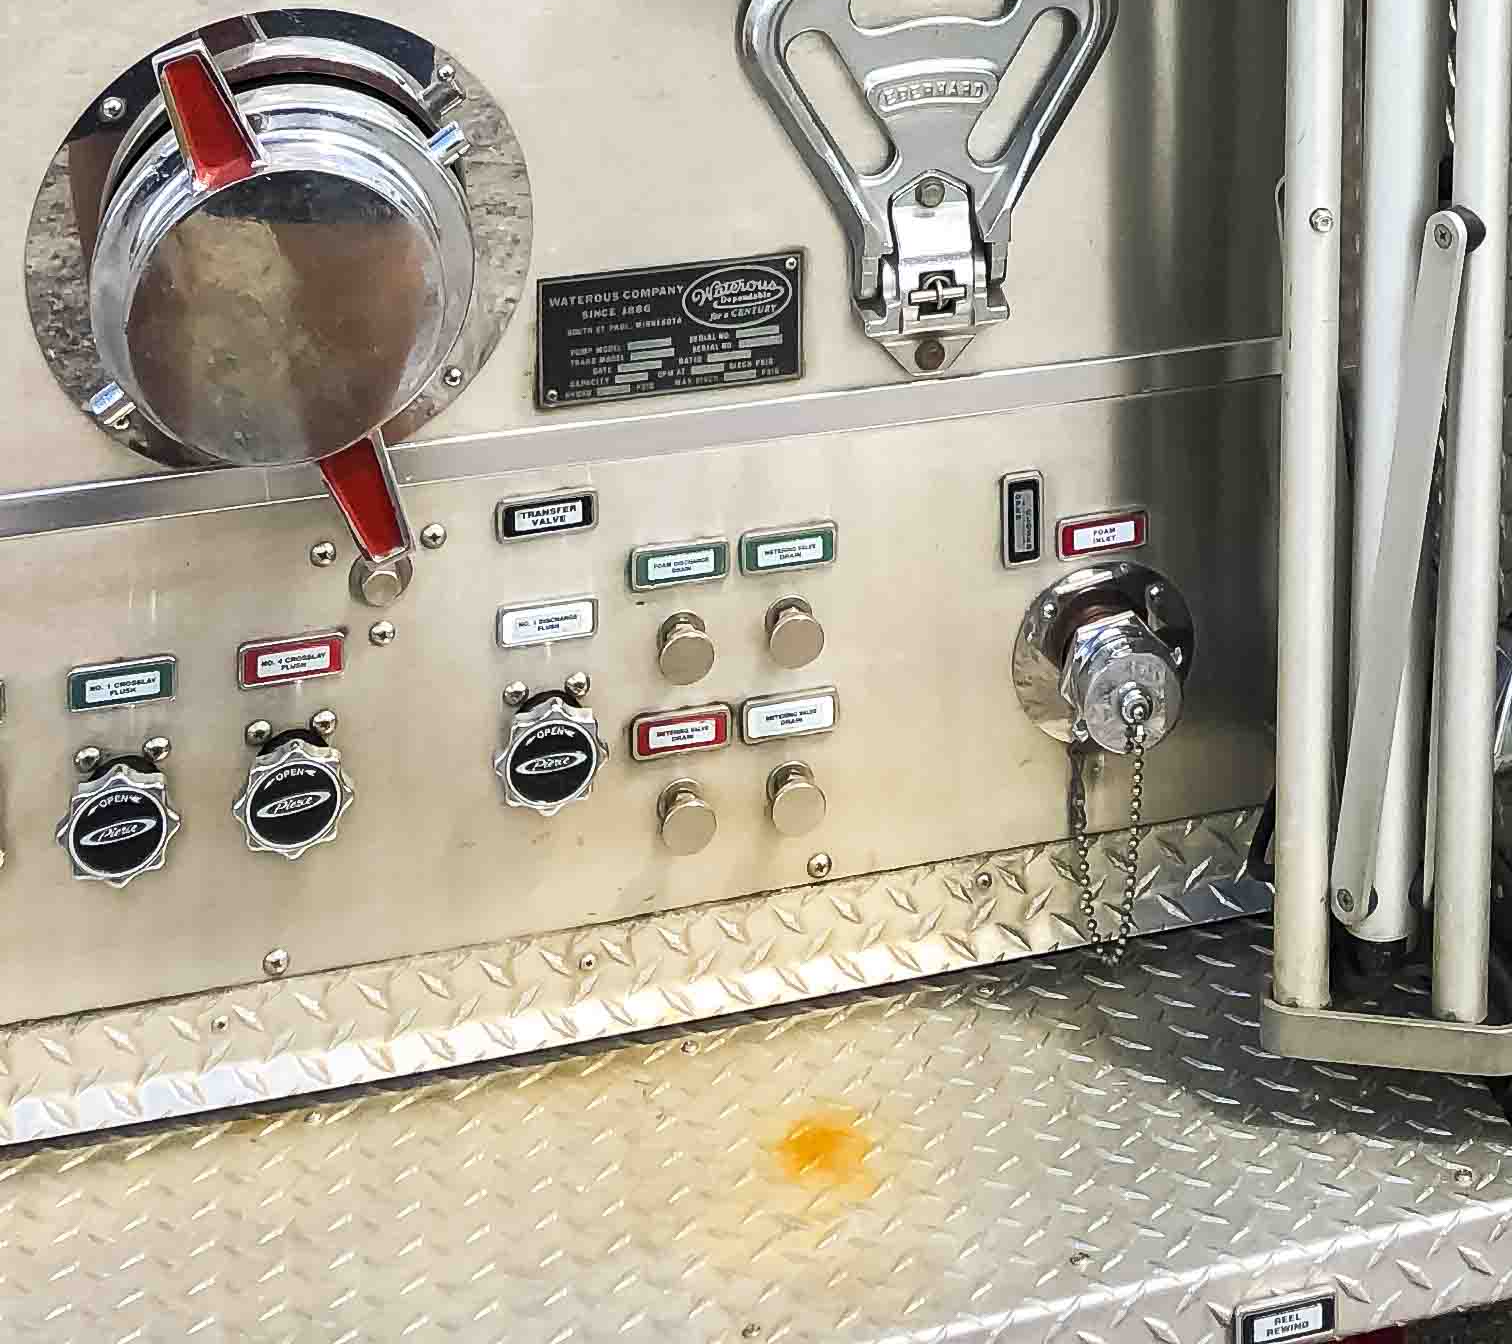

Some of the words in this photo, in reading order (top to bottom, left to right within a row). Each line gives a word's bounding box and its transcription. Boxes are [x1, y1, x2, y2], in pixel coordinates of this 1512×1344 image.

[548, 291, 620, 308] WATEROUS
[622, 284, 685, 301] COMPANY
[691, 278, 779, 307] Waterous
[720, 291, 772, 304] Dependable
[582, 307, 617, 320] SINCE
[730, 303, 777, 318] CENTURY
[520, 504, 577, 520] TRANSFER
[531, 514, 567, 526] VALVE
[1093, 527, 1116, 537] FOAM
[1093, 535, 1117, 544] INLET
[779, 551, 802, 560] DRAIN
[653, 561, 672, 569] FOAM
[284, 651, 327, 663] CROSSLAY
[280, 662, 307, 671] FLUSH
[89, 684, 104, 692] NO.
[113, 677, 157, 689] CROSSLAY
[109, 687, 137, 696] FLUSH
[537, 726, 564, 739] OPEN
[275, 768, 305, 782] OPEN
[98, 794, 129, 808] OPEN
[273, 796, 313, 815] Pierce
[97, 824, 139, 842] Pierce
[1273, 1313, 1302, 1326] REEL
[1265, 1320, 1310, 1337] REWIND
